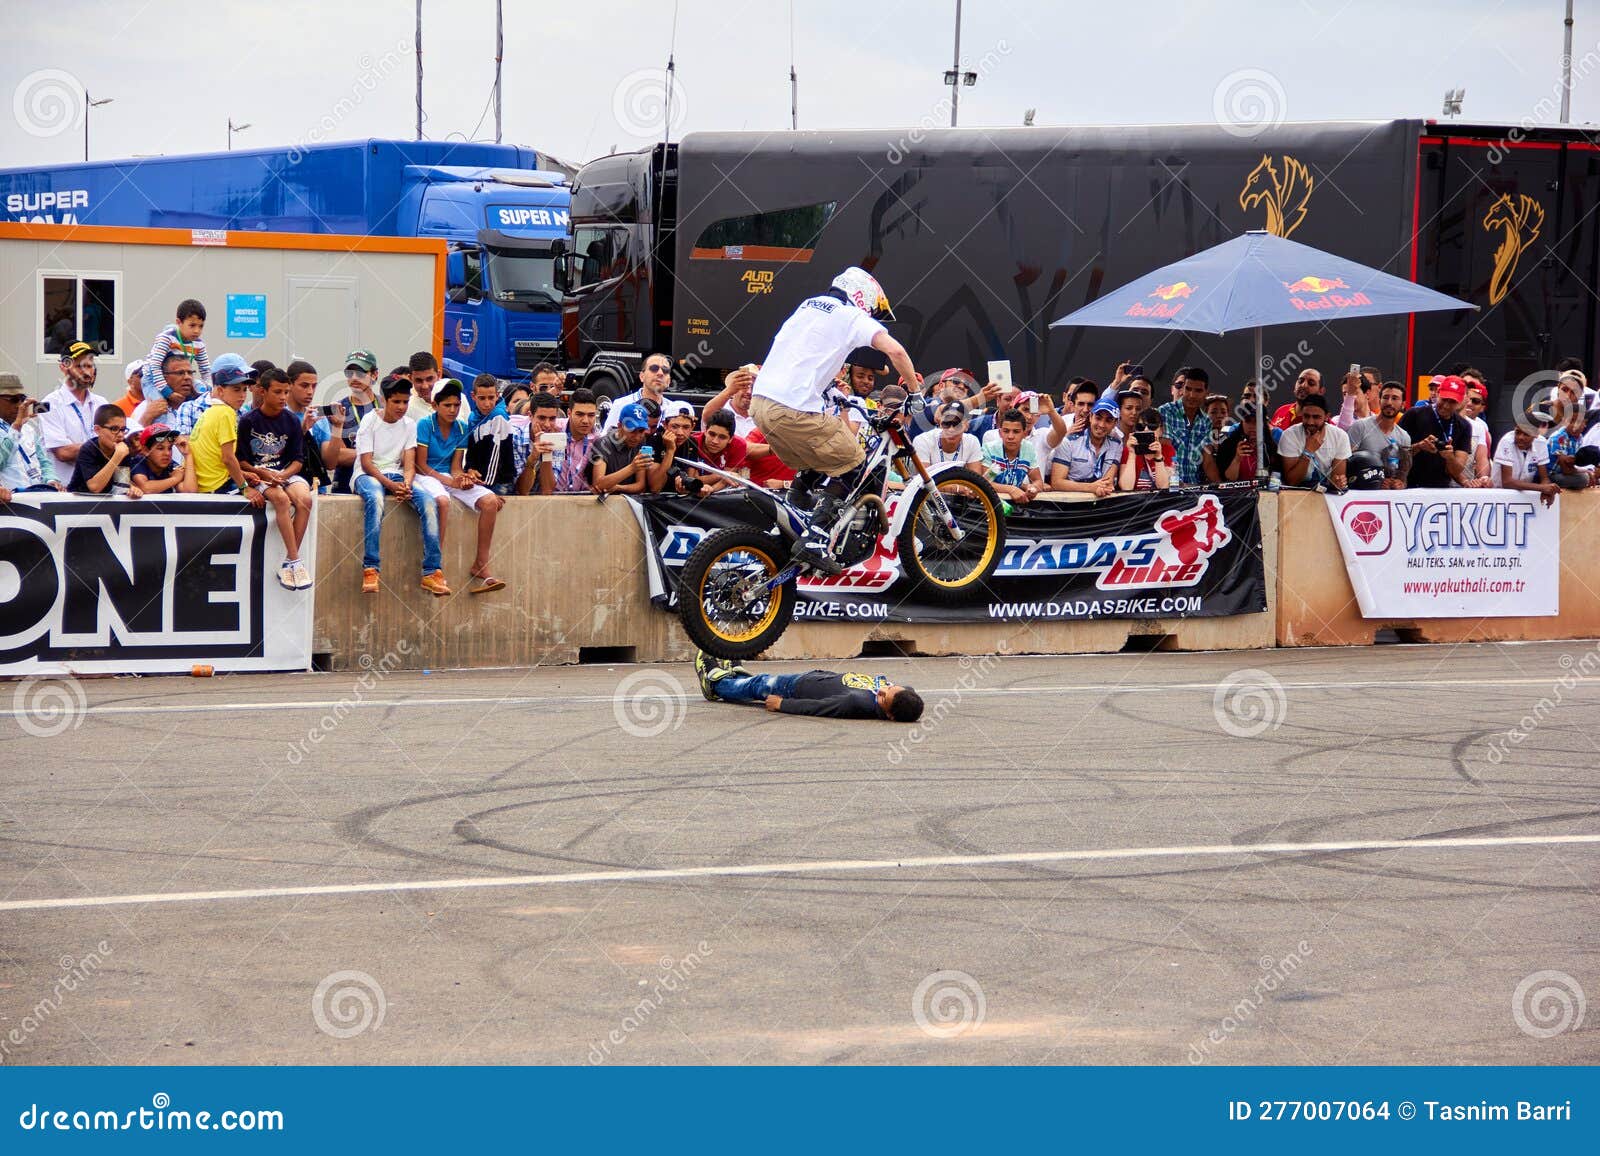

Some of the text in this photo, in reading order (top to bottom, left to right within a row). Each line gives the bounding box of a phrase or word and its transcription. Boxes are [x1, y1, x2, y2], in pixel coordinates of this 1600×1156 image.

[7, 190, 88, 212] SUPER
[499, 209, 551, 225] SUPER
[741, 270, 774, 282] AUTO
[1124, 303, 1185, 318] Red Bull
[1290, 292, 1373, 311] Red Bull
[1395, 503, 1535, 553] YAKUT
[1001, 538, 1162, 570] DADA'S
[1407, 557, 1424, 568] HALI
[1426, 557, 1446, 568] TEKS.
[1449, 557, 1465, 568] SAN.
[1467, 560, 1475, 568] ve
[1493, 557, 1507, 568] LTD.
[1103, 557, 1202, 585] bike
[1403, 577, 1526, 598] www.yakuthali.com.tr
[988, 596, 1202, 617] WWW.DADASBIKE.COM
